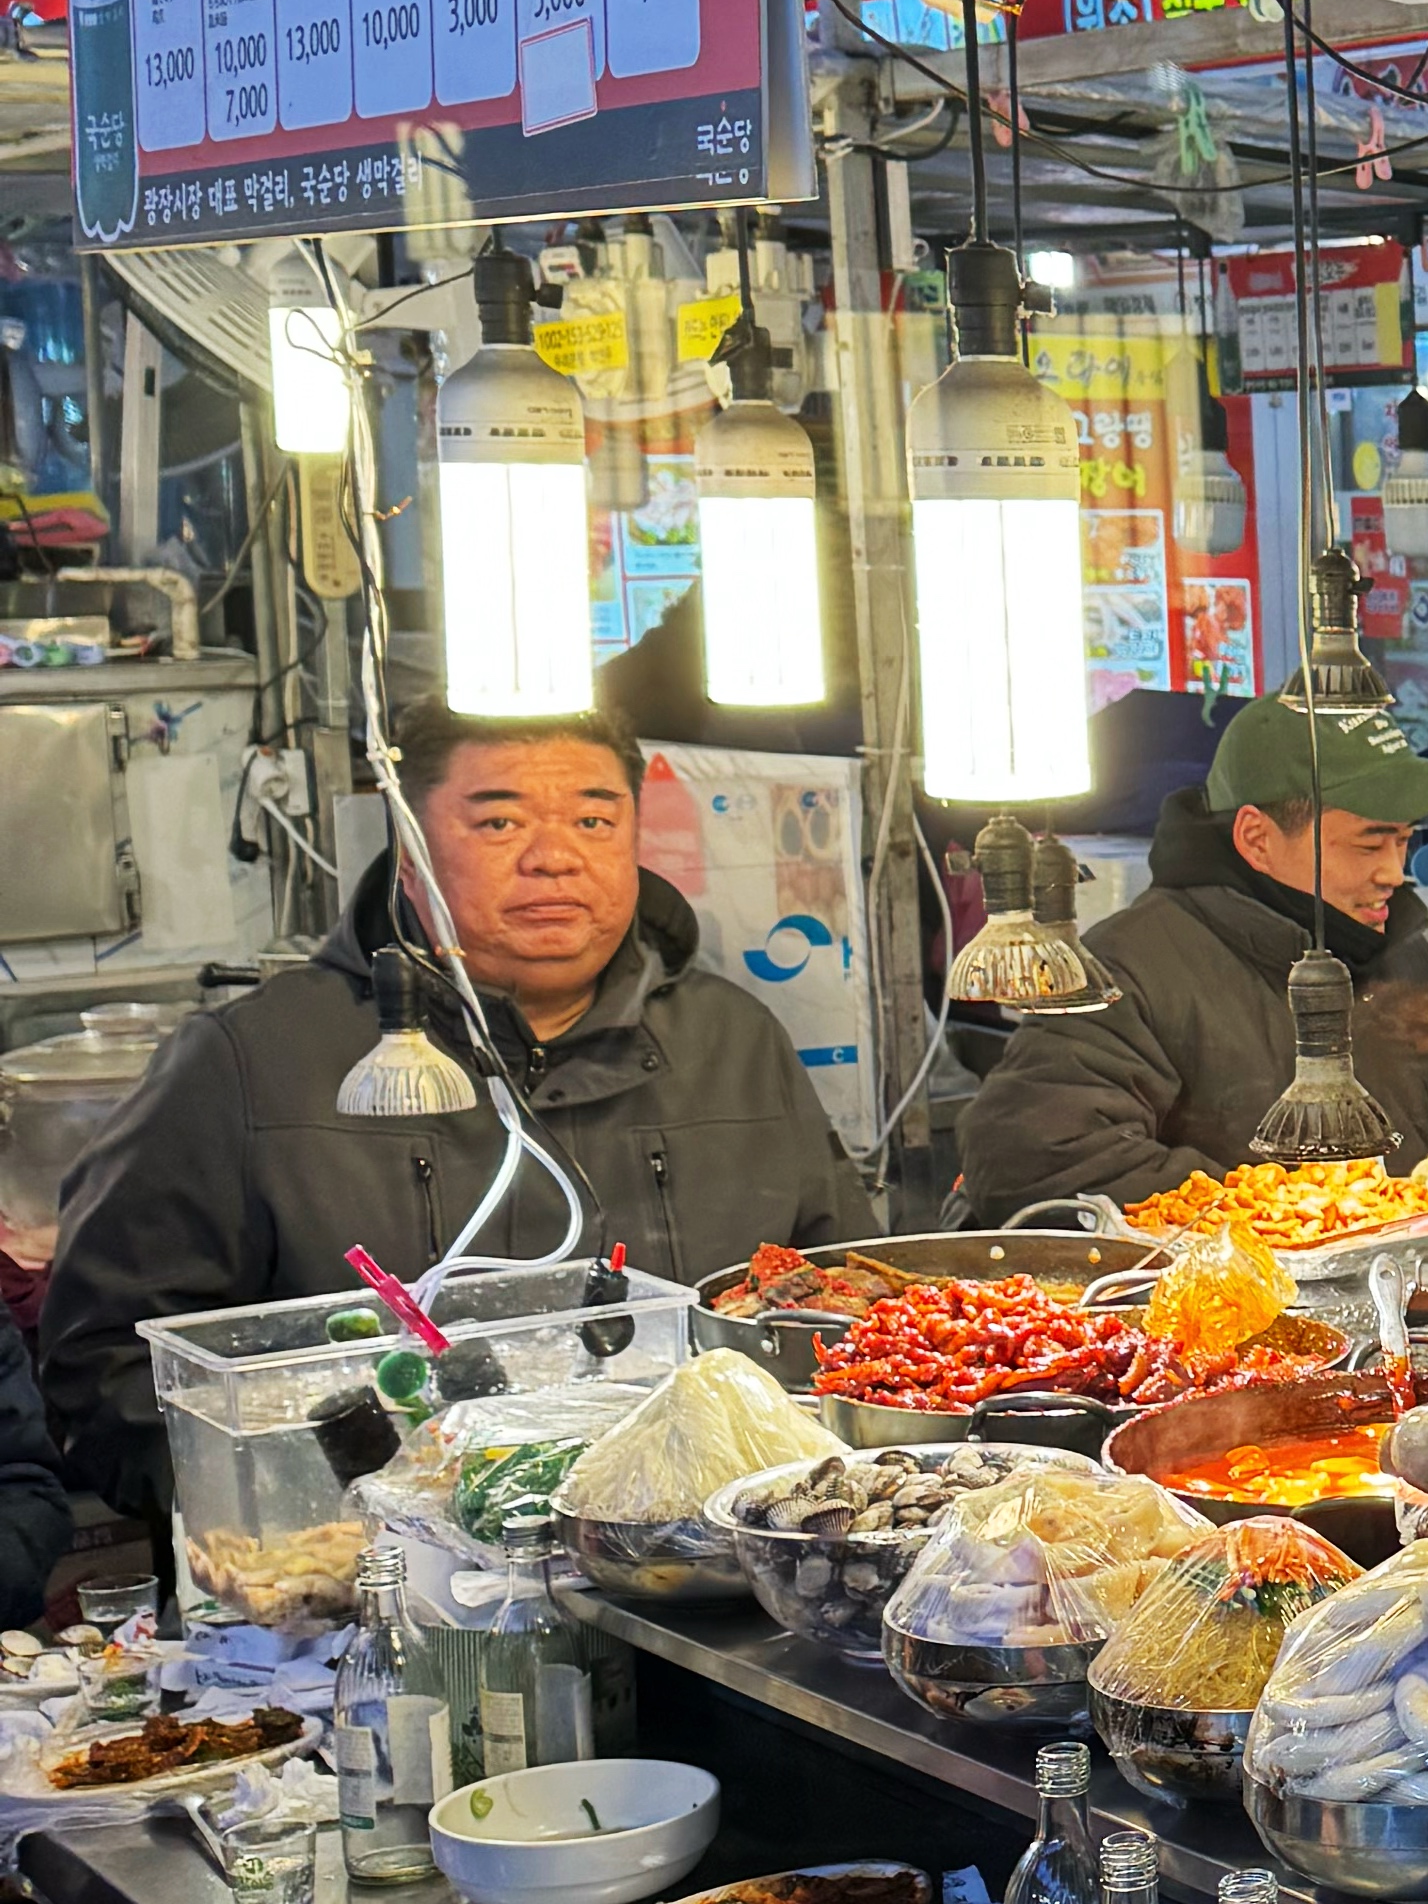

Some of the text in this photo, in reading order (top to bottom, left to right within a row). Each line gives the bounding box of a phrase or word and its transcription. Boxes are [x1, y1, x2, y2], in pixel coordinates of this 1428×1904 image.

[286, 18, 340, 63] 13,000
[362, 3, 420, 49] 10,000
[146, 47, 194, 89] 13,000
[215, 33, 267, 77] 10,000
[225, 83, 268, 126] 7,000
[697, 116, 752, 156] 국순당
[144, 182, 202, 226] 광장시장
[208, 177, 239, 217] 대표
[300, 160, 350, 205] 국순당
[355, 151, 423, 200] 생막걸리
